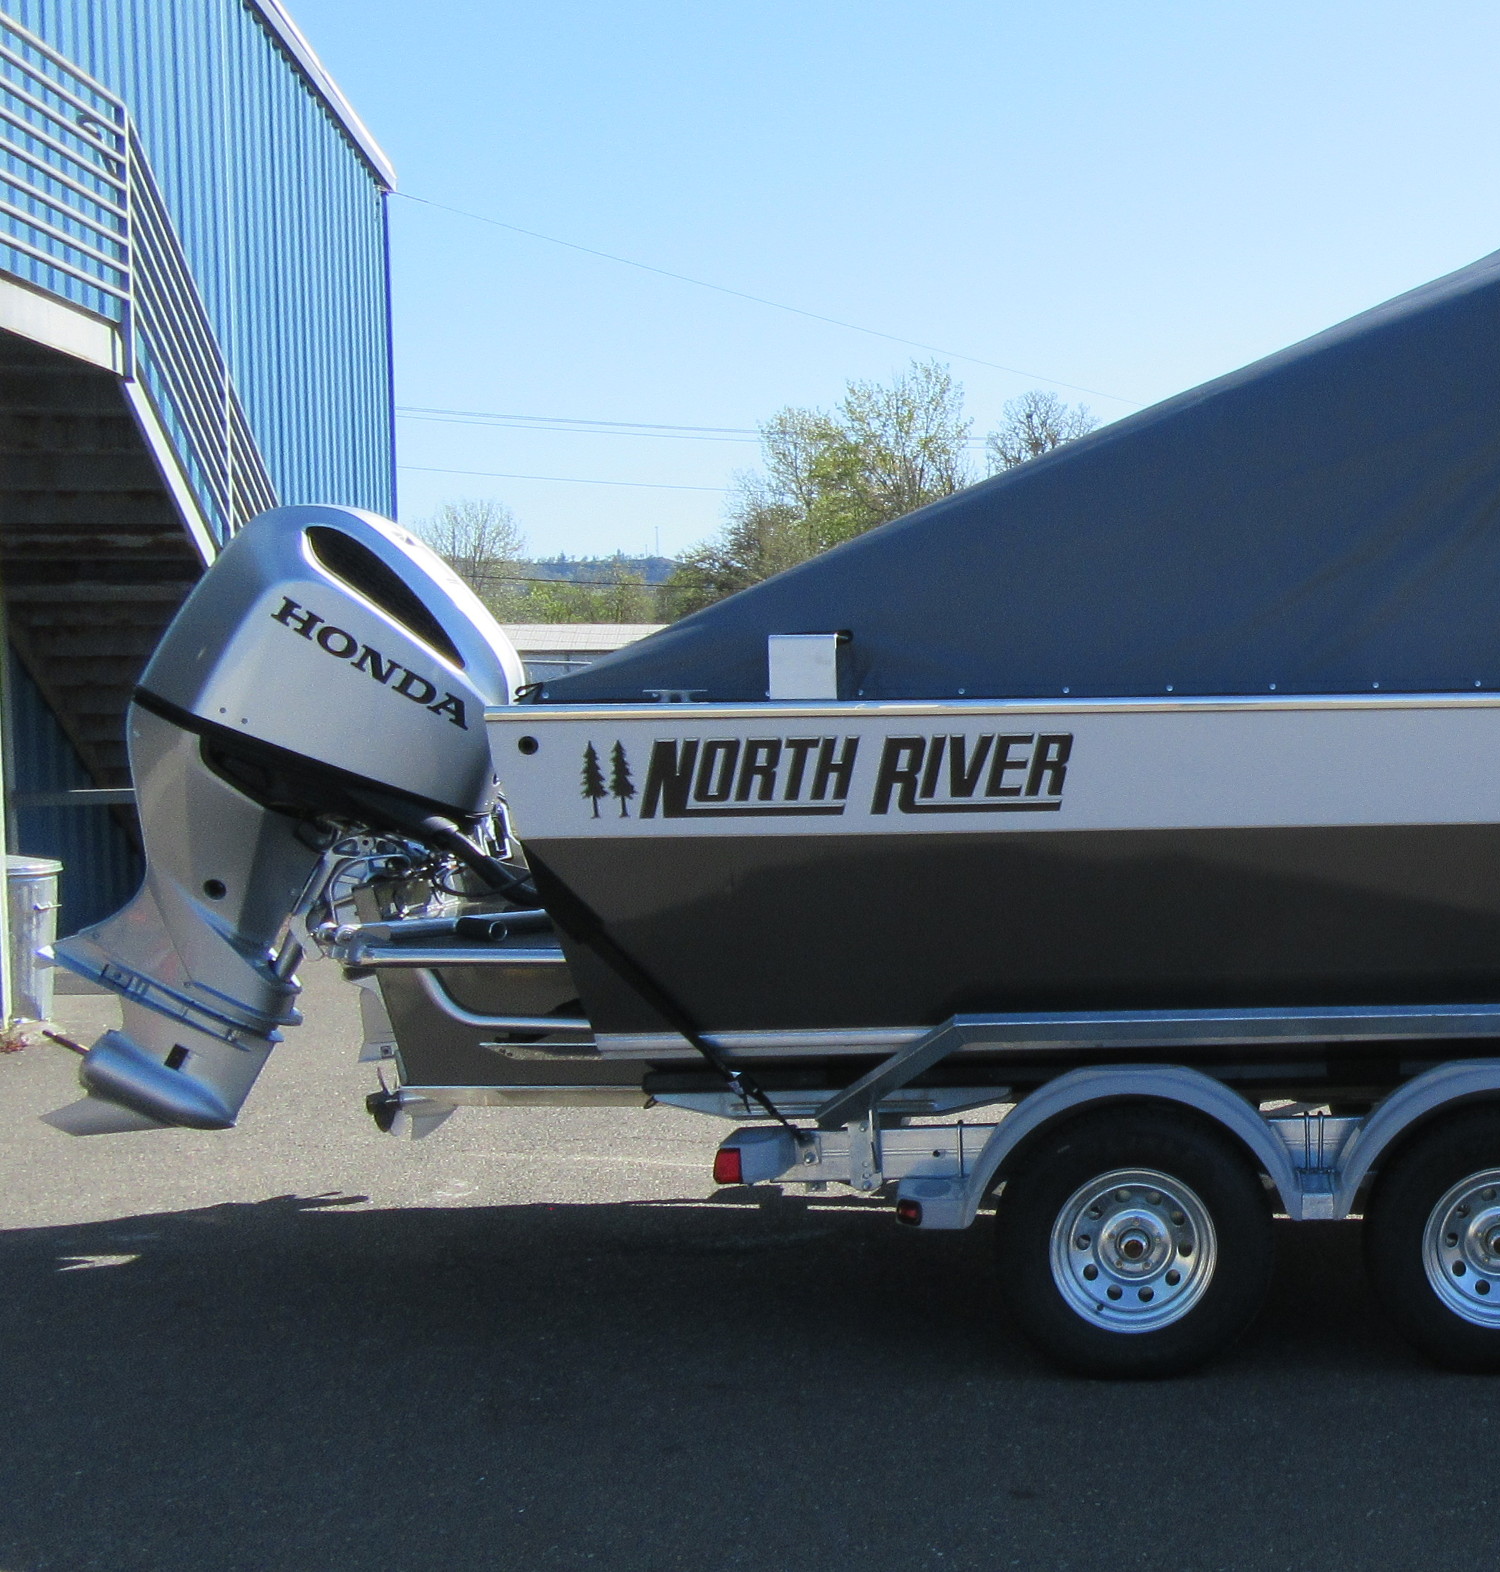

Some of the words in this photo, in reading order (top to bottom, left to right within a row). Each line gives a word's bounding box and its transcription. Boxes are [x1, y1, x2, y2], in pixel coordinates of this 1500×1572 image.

[271, 596, 468, 731] HONDA
[639, 735, 860, 819] NORTH
[870, 733, 1074, 816] RIVER
